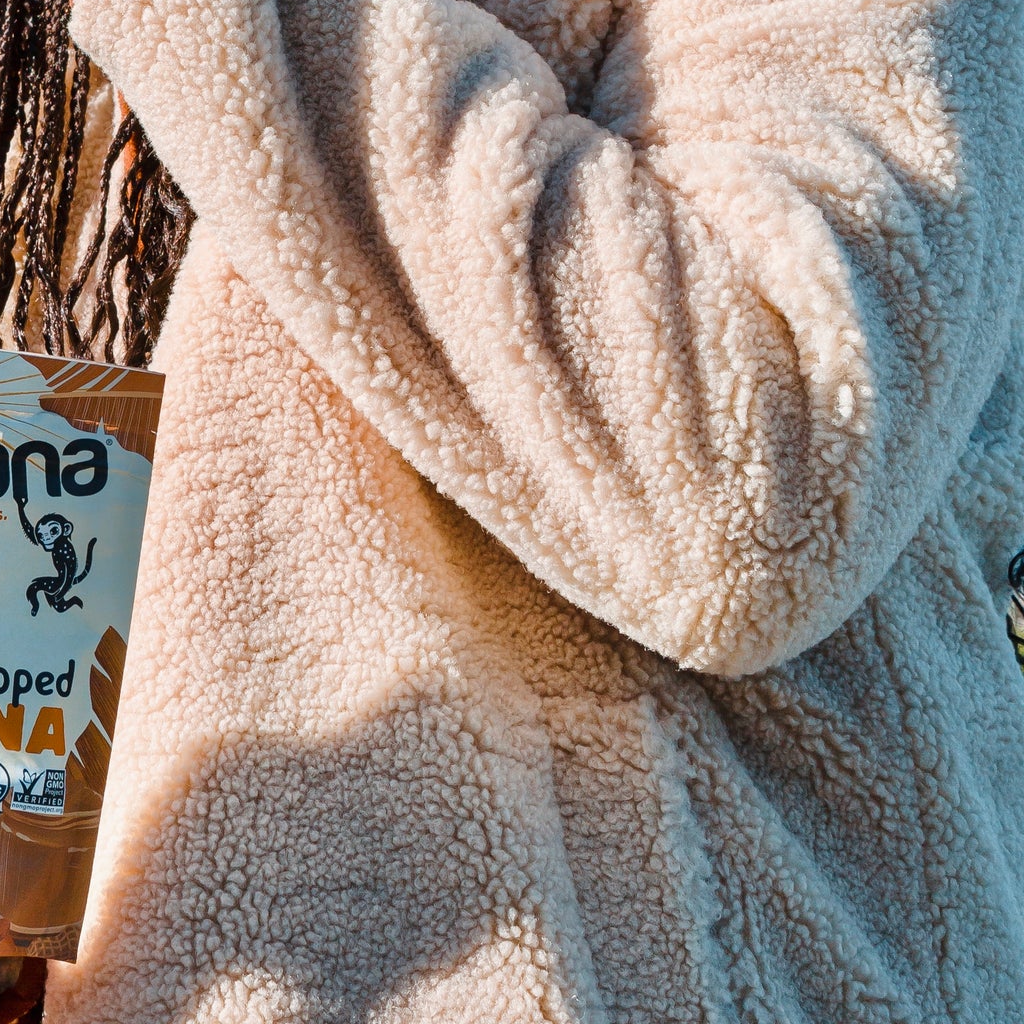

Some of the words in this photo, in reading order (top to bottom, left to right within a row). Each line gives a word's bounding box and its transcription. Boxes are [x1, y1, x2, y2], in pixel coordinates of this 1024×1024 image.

[47, 771, 64, 781] NON
[46, 779, 64, 789] GMO
[45, 788, 64, 797] Project
[17, 795, 63, 806] VERIFIED
